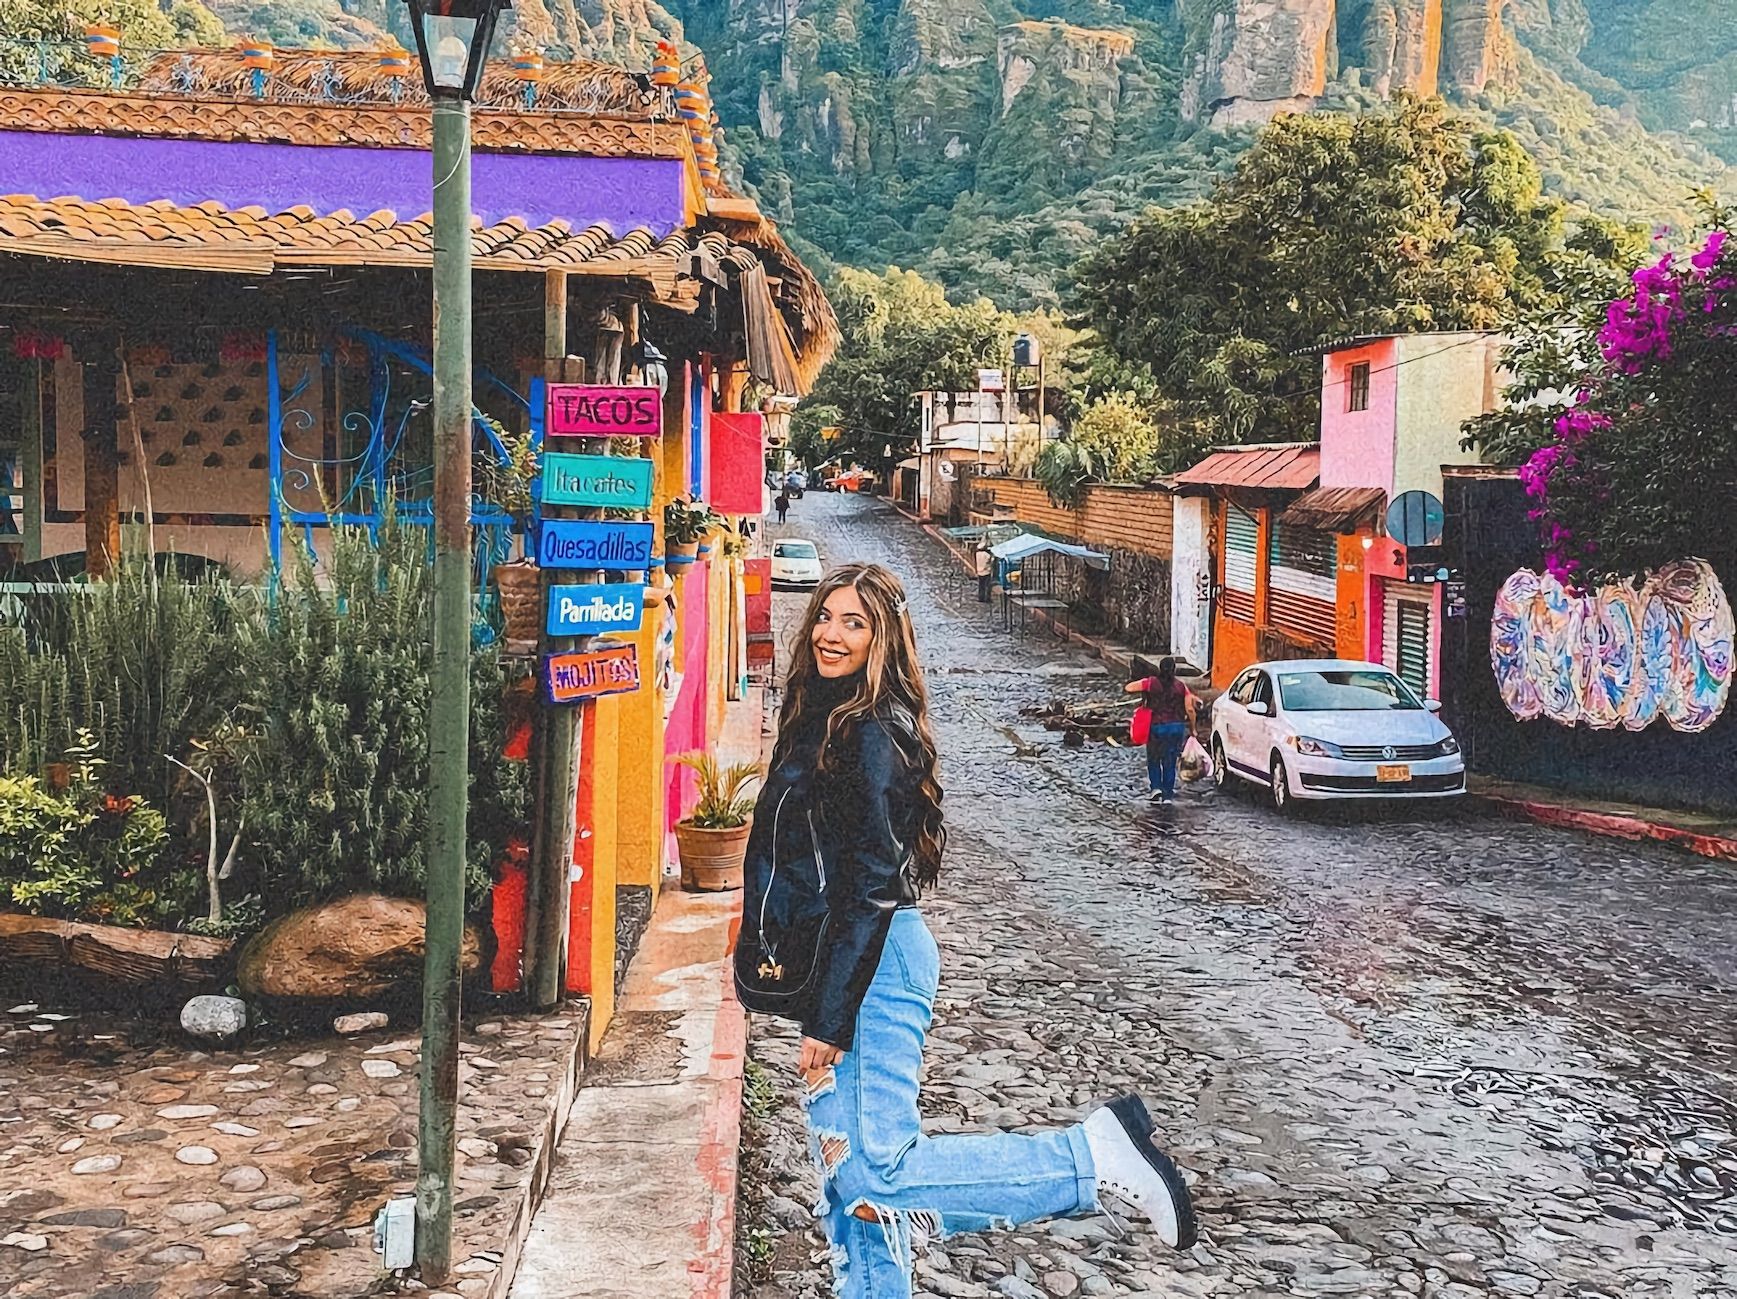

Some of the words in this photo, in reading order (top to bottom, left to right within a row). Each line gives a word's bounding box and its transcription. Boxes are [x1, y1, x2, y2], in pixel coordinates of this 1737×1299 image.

[557, 395, 654, 425] TACOS
[553, 466, 637, 495] Itacates
[545, 530, 648, 562] Quesadillas
[559, 595, 635, 623] Parrillada
